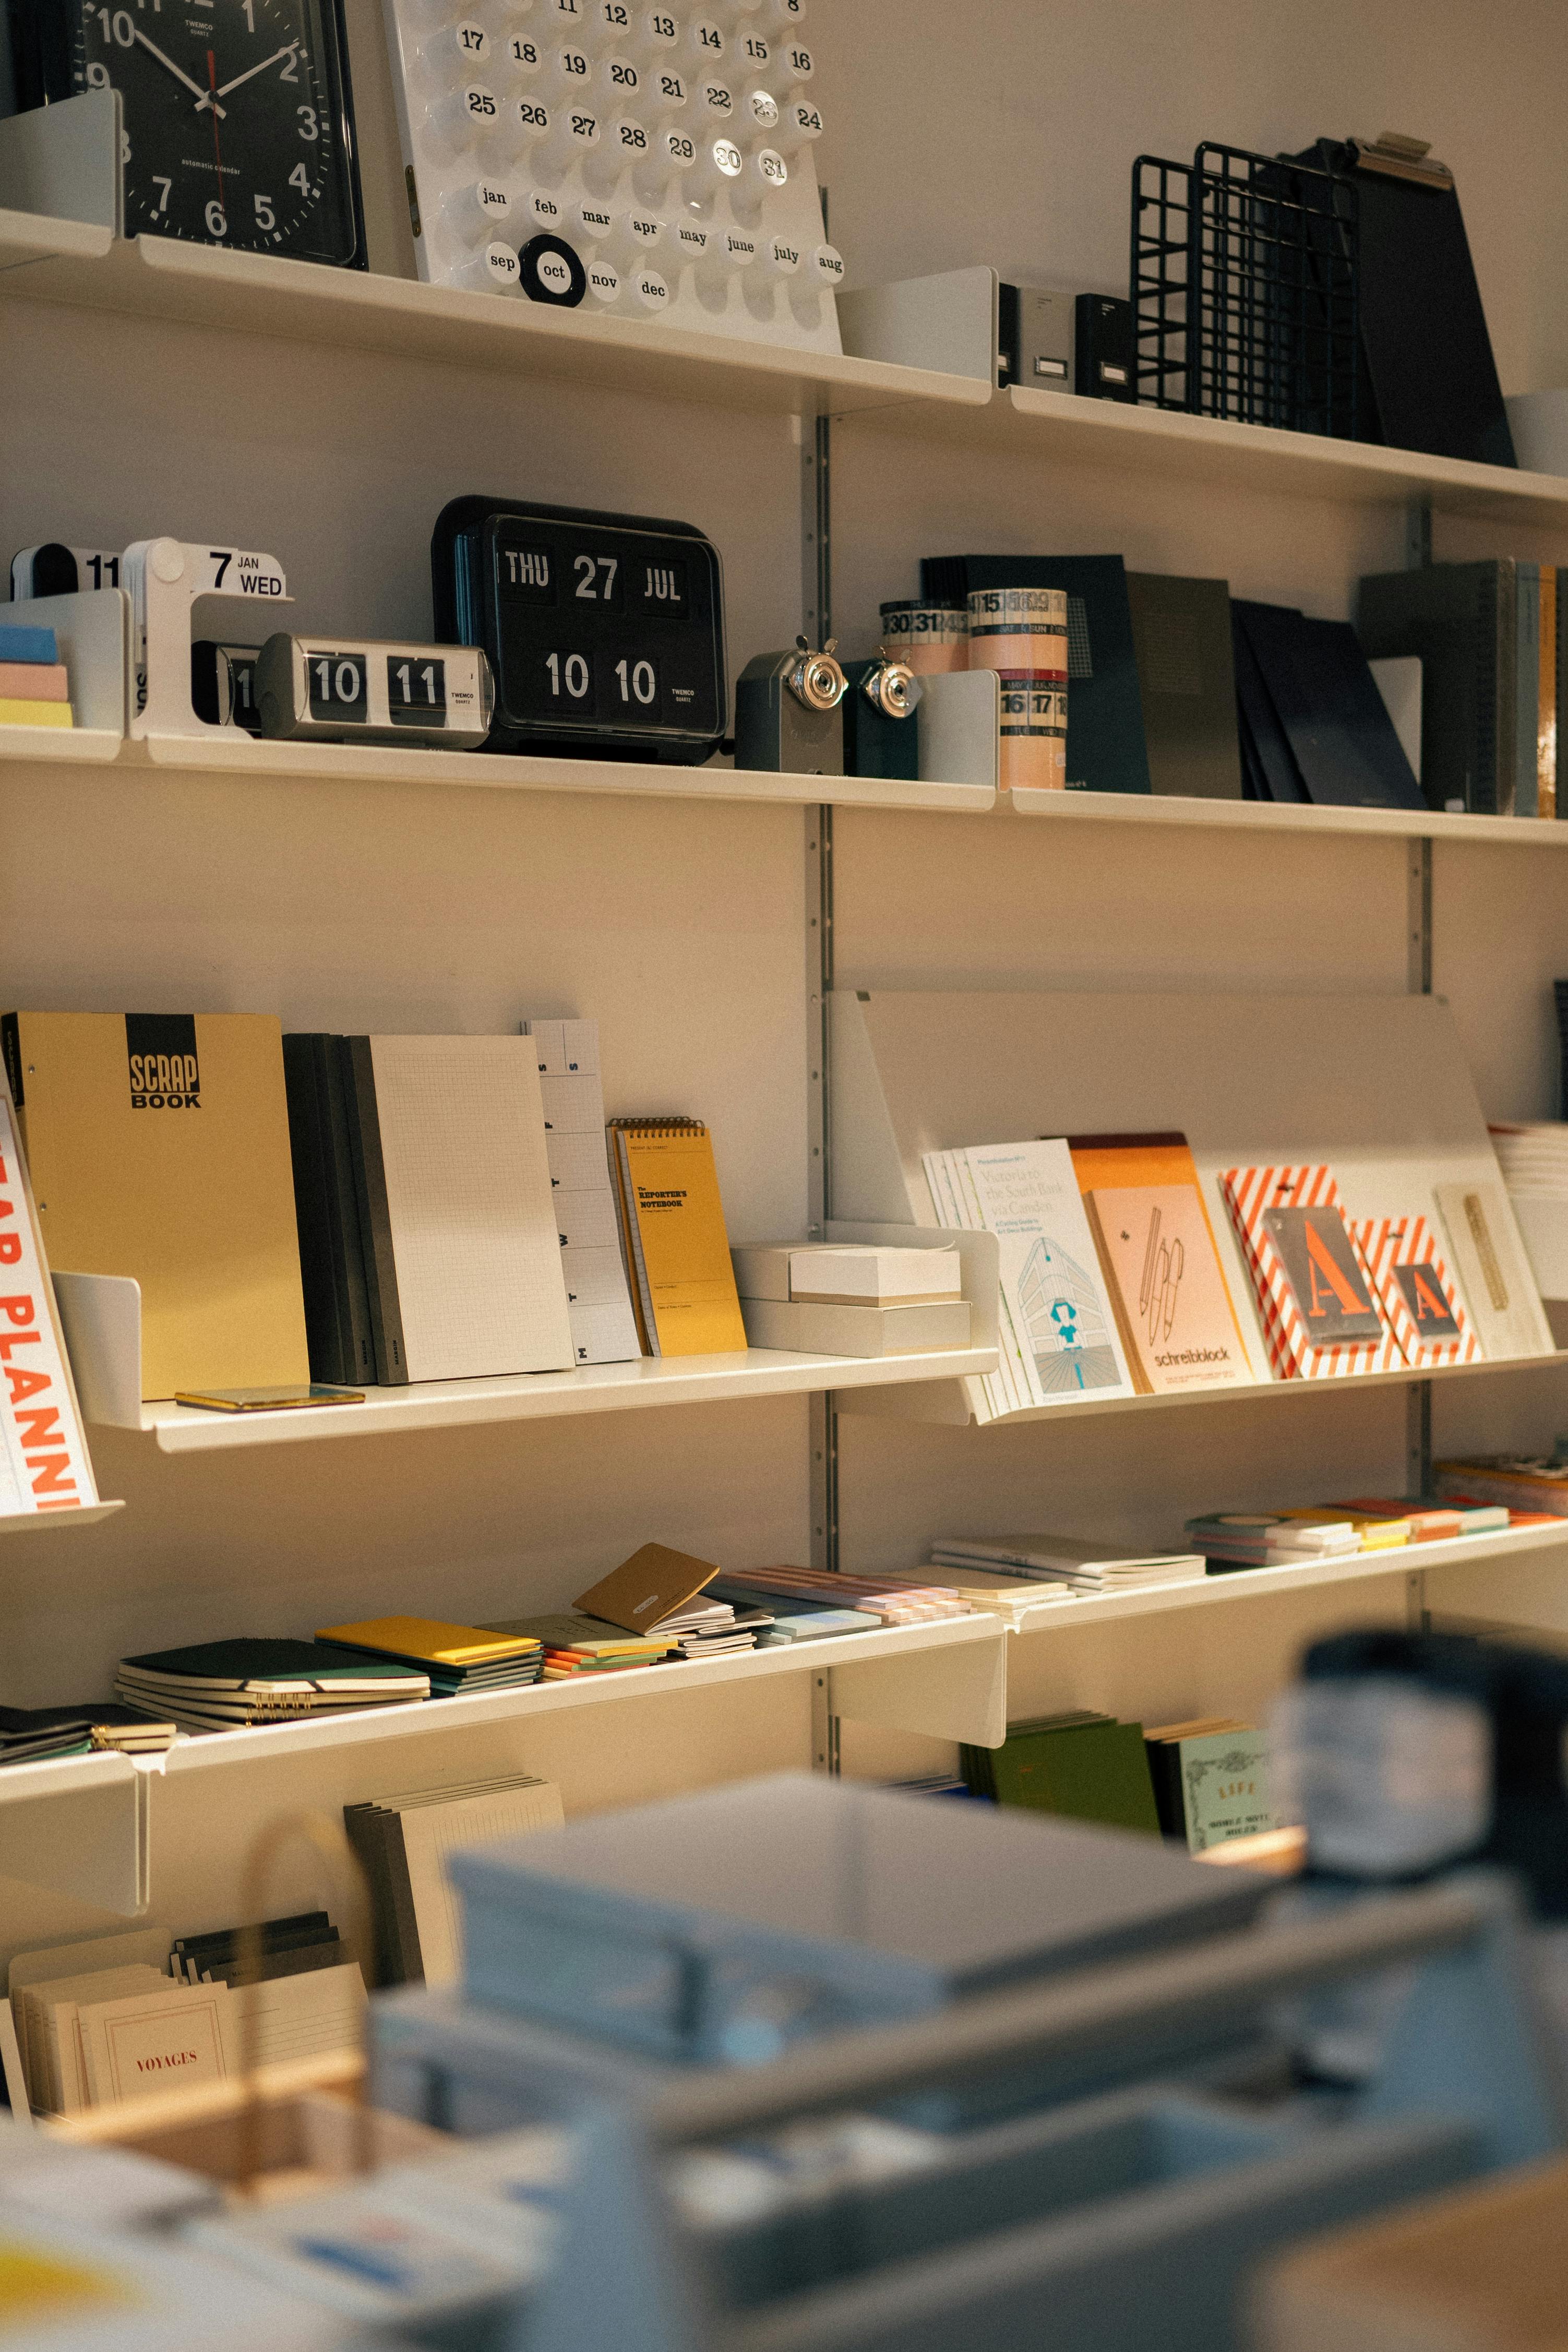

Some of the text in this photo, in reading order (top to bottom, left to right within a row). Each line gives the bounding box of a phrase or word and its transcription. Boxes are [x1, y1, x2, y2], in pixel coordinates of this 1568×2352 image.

[98, 8, 135, 47] 10
[185, 19, 212, 30] TWEMCO
[190, 29, 209, 37] QUARTZ
[605, 4, 811, 71] 12 13 14 15 16
[87, 63, 110, 89] 9
[279, 47, 298, 82] 2
[462, 29, 822, 129] 17 18 19 20 21 22 23 24
[297, 106, 318, 140] 3
[469, 93, 785, 179] 25 26 27 28 29 30 31
[182, 159, 213, 170] automatic
[289, 163, 310, 196] 4
[152, 176, 171, 211] 7
[205, 201, 227, 236] 6
[255, 195, 275, 230] 5
[483, 187, 842, 273] jan feb mar apr may june july aug
[490, 254, 665, 297] sep oct nov dec
[87, 555, 119, 590] 11
[210, 552, 232, 588] 7
[237, 557, 258, 569] JAN
[505, 551, 680, 601] THU 27 JUL
[241, 575, 282, 595] WED
[916, 613, 937, 632] 31
[316, 661, 435, 703] 10 11
[546, 653, 655, 704] 10 10
[1001, 694, 1024, 713] 16
[1034, 694, 1051, 713] 17
[130, 1055, 198, 1092] SCRAP
[131, 1094, 202, 1109] BOOK
[559, 1234, 568, 1247] W
[1306, 1221, 1370, 1317] A
[569, 1294, 577, 1302] T
[1414, 1271, 1449, 1320] A
[578, 1348, 587, 1358] M
[1155, 1347, 1230, 1367] schreibblock
[137, 2051, 197, 2072] VOYAGES
